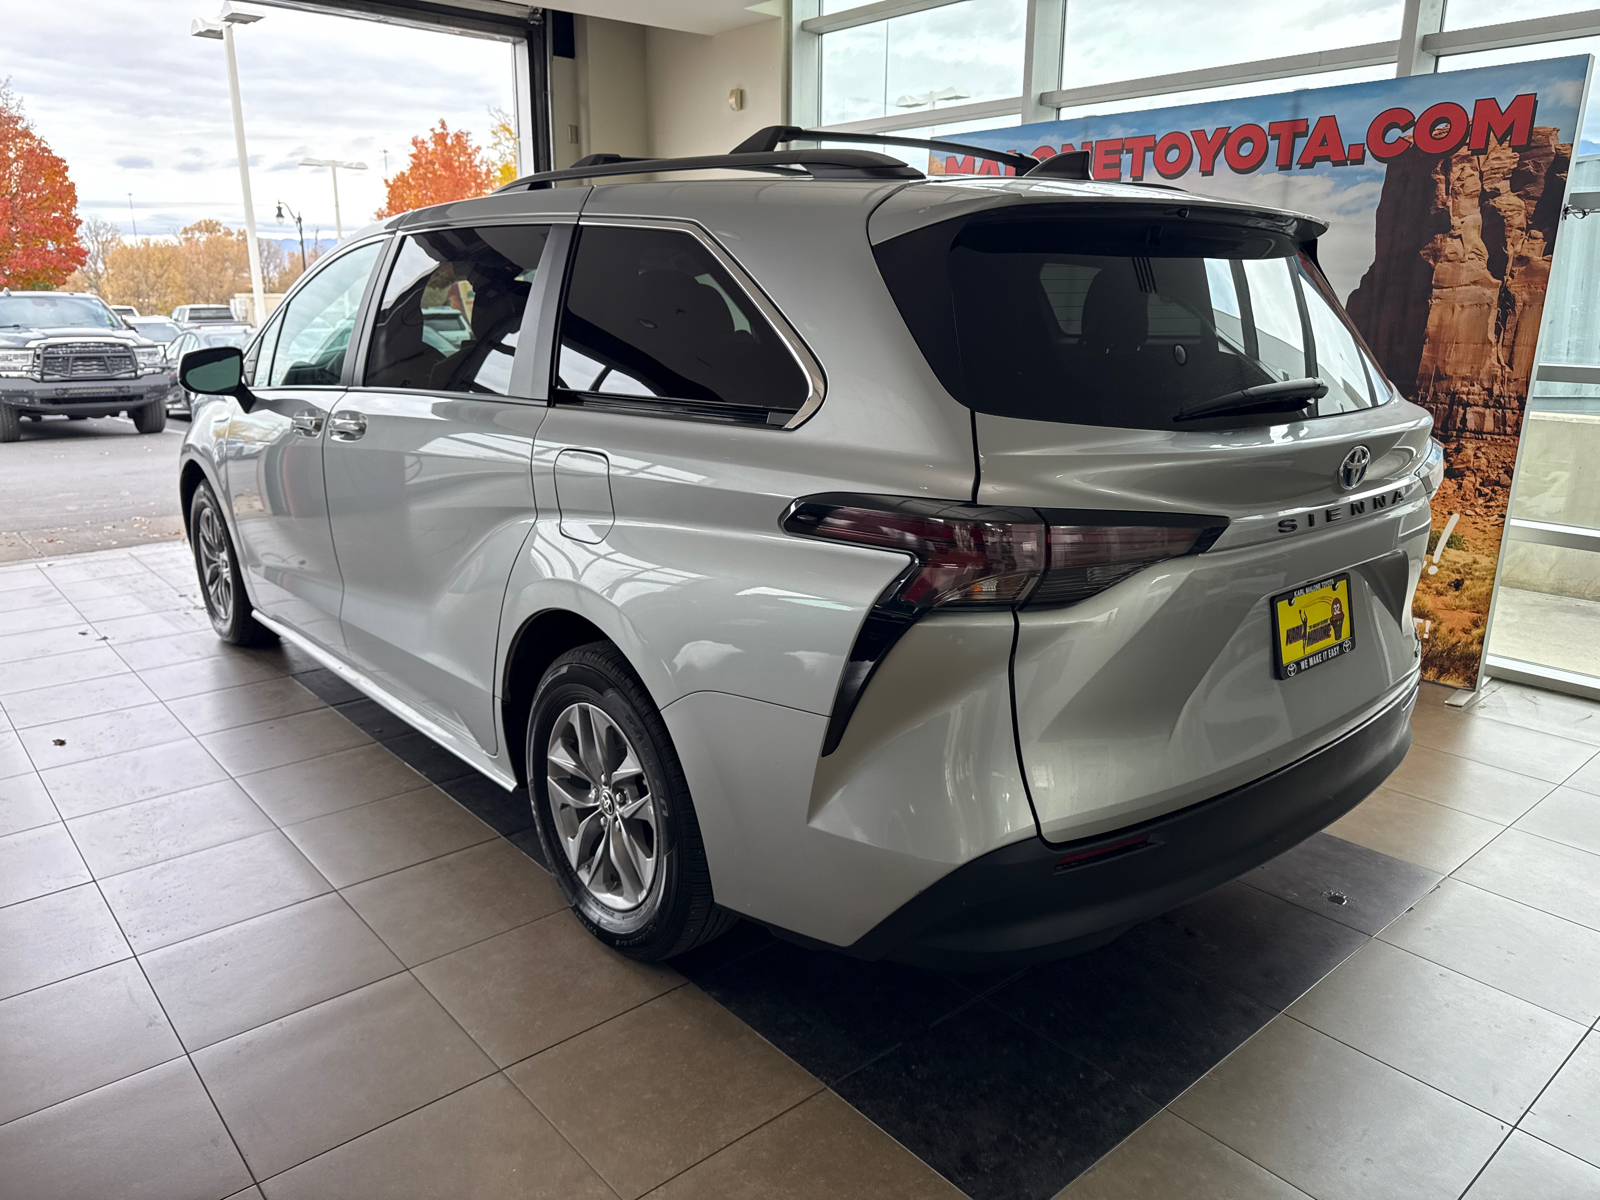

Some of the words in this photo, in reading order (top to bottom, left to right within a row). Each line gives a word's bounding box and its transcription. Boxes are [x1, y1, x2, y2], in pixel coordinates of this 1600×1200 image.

[945, 93, 1538, 182] METOYOTA.COM
[1278, 490, 1405, 533] SIENNA
[1294, 588, 1305, 597] KARL
[1305, 582, 1321, 593] MALONE
[1321, 579, 1334, 588] TOYOTA
[1333, 603, 1341, 615] 32
[1300, 660, 1308, 670] WE
[1309, 653, 1322, 667] MAKE
[1322, 650, 1328, 661] IT
[1328, 645, 1340, 659] EASY
